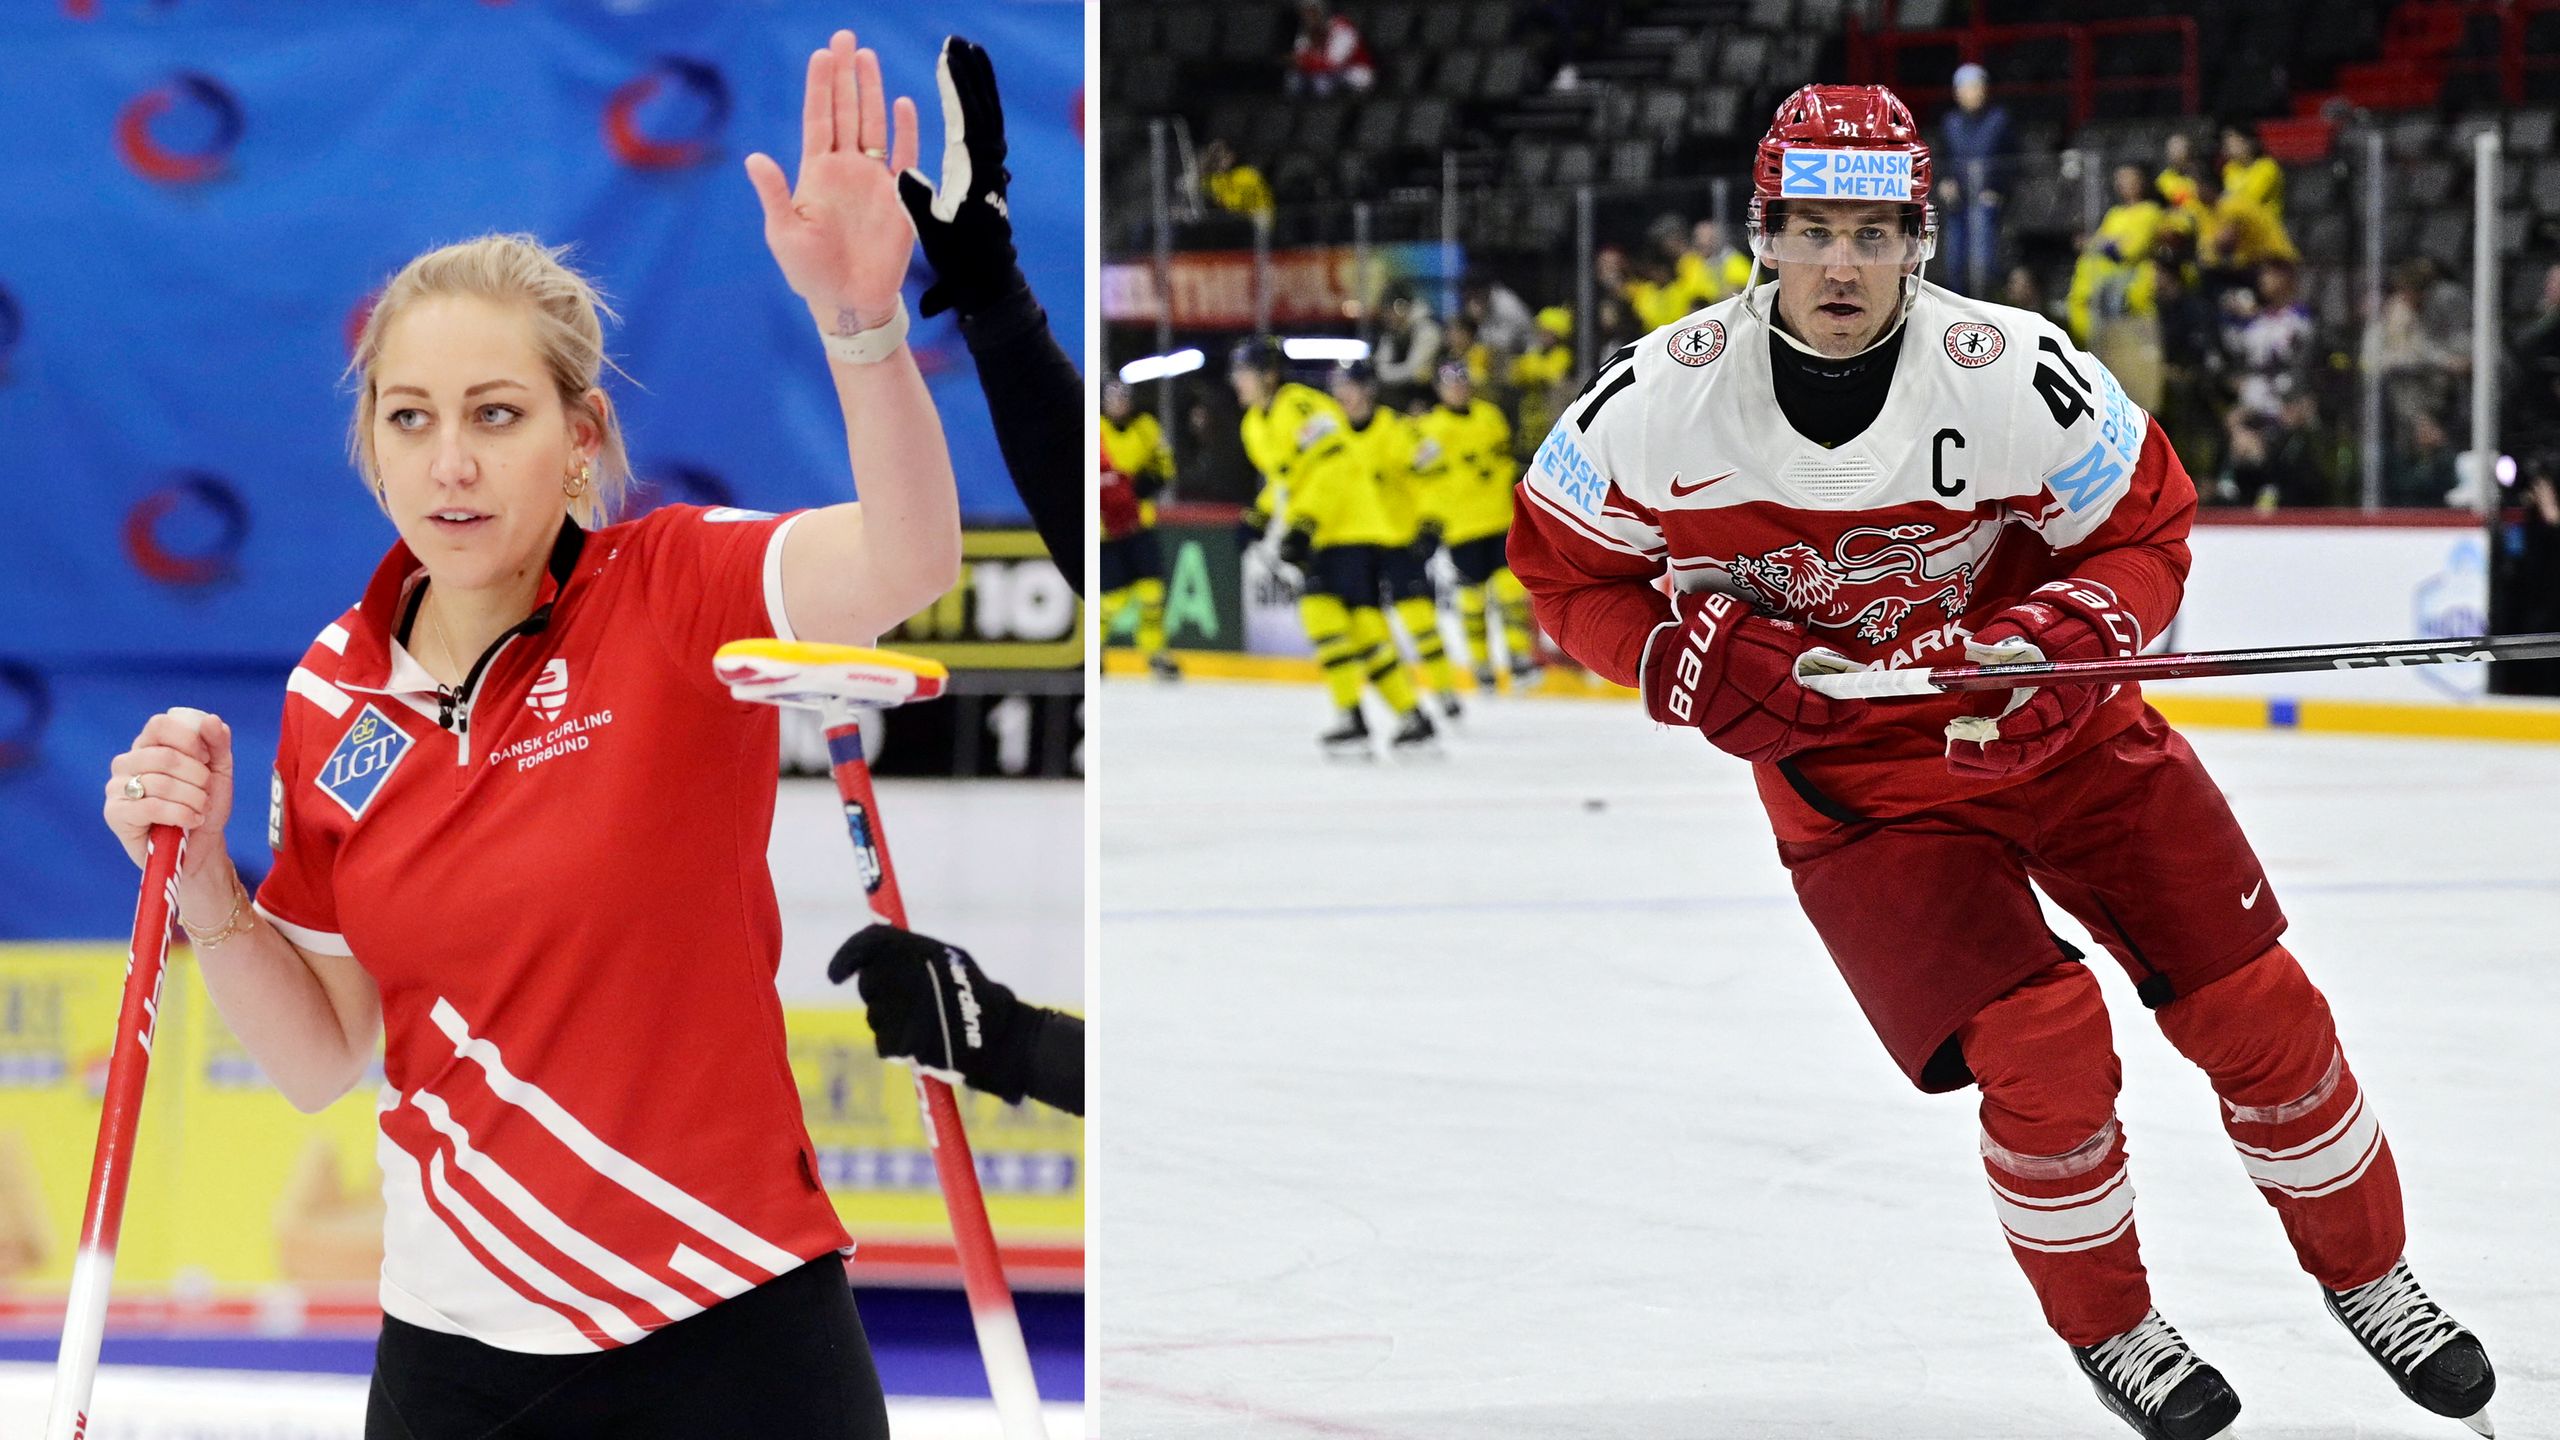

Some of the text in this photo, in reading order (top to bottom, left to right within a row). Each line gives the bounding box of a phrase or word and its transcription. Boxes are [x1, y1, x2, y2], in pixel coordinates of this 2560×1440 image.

[1834, 119, 1859, 137] 41
[1833, 154, 1911, 175] DANSK
[1833, 176, 1908, 198] METAL
[1947, 335, 1988, 366] DANMARKS
[2032, 335, 2095, 430] 41
[1551, 418, 1607, 500] ANSK
[1932, 428, 1966, 497] C
[1865, 619, 1975, 673] MARK
[330, 732, 398, 789] LGT
[489, 709, 613, 766] DANSK CURLING
[517, 735, 590, 773] FORBUND
